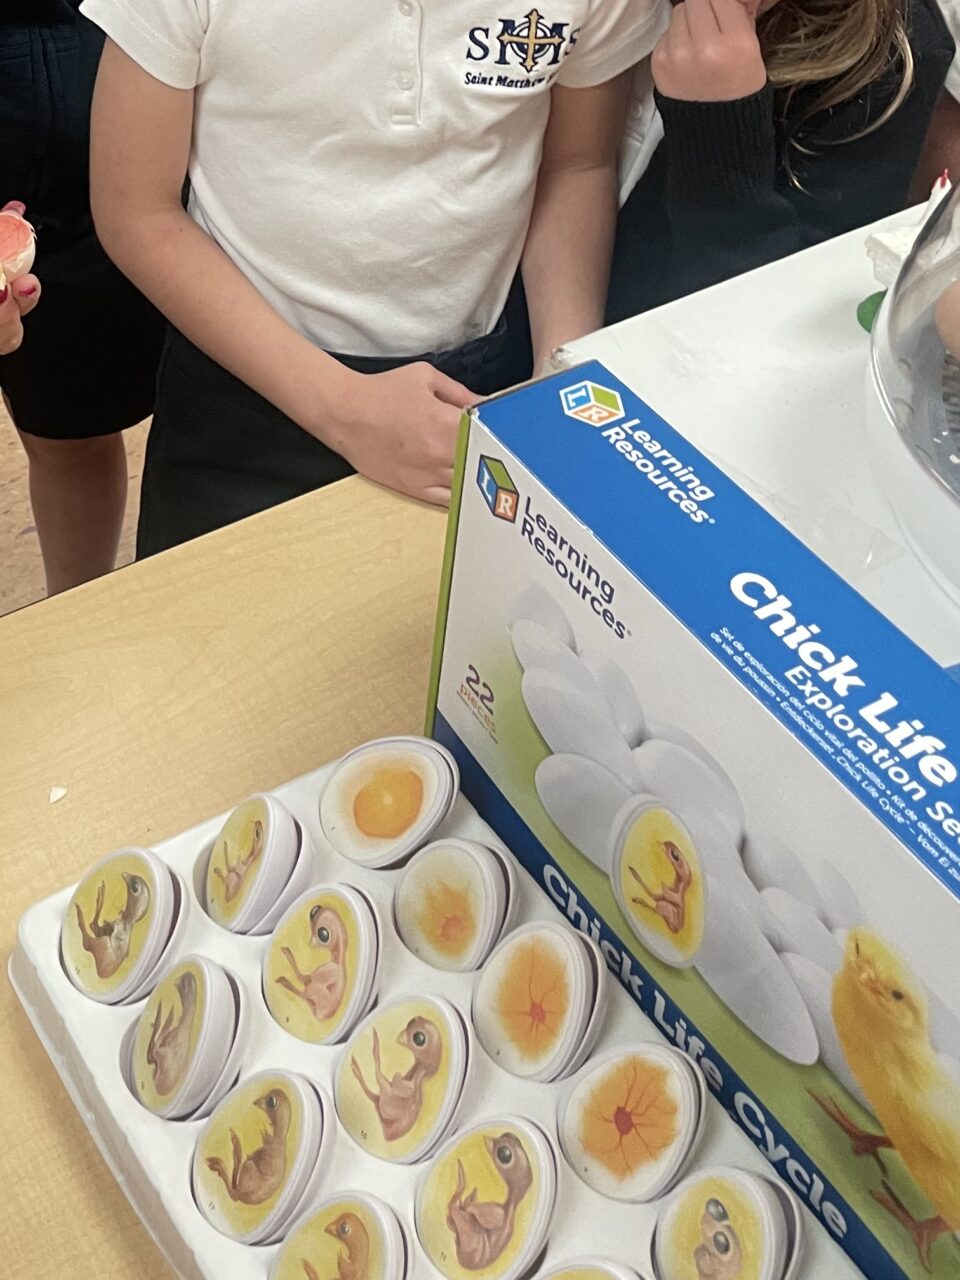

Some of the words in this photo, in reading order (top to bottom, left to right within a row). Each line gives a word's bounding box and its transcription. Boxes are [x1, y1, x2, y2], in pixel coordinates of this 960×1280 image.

[464, 72, 494, 86] Saint
[621, 418, 715, 501] Learning
[524, 496, 615, 605] Learning
[465, 664, 495, 716] 22
[710, 632, 723, 644] de
[742, 666, 776, 697] poussin
[836, 755, 862, 782] Chick
[861, 780, 879, 798] Life
[719, 627, 735, 642] Set
[732, 641, 745, 652] de
[789, 696, 807, 711] del
[803, 710, 825, 731] ciclo
[842, 748, 859, 763] del
[730, 572, 866, 697] Chick
[858, 692, 958, 788] Life
[783, 665, 928, 801] Exploration
[926, 801, 960, 846] Se
[543, 864, 643, 1001] Chick
[654, 989, 724, 1091] Life
[734, 1091, 848, 1239] Cycle
